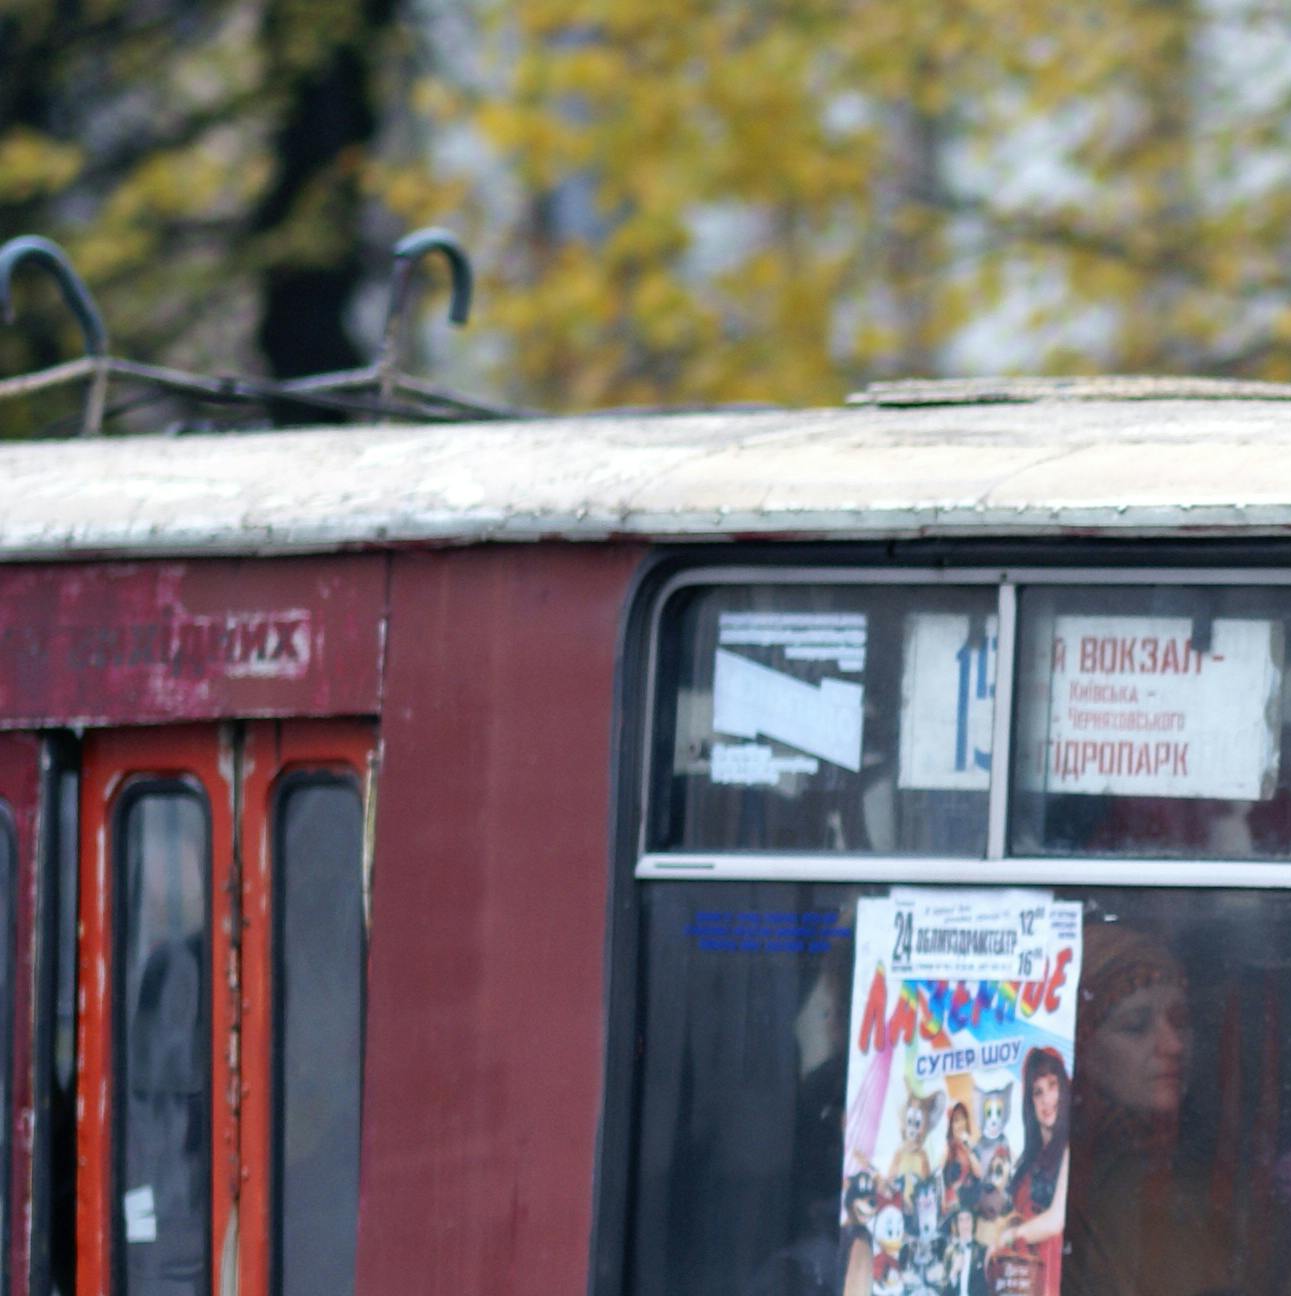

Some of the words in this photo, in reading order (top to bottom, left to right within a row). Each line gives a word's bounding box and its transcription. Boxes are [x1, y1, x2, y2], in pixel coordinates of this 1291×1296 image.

[1079, 635, 1204, 675] ВОКЗАЛ
[916, 1048, 976, 1076] СУПЕР
[981, 1040, 1022, 1066] ШОУ
